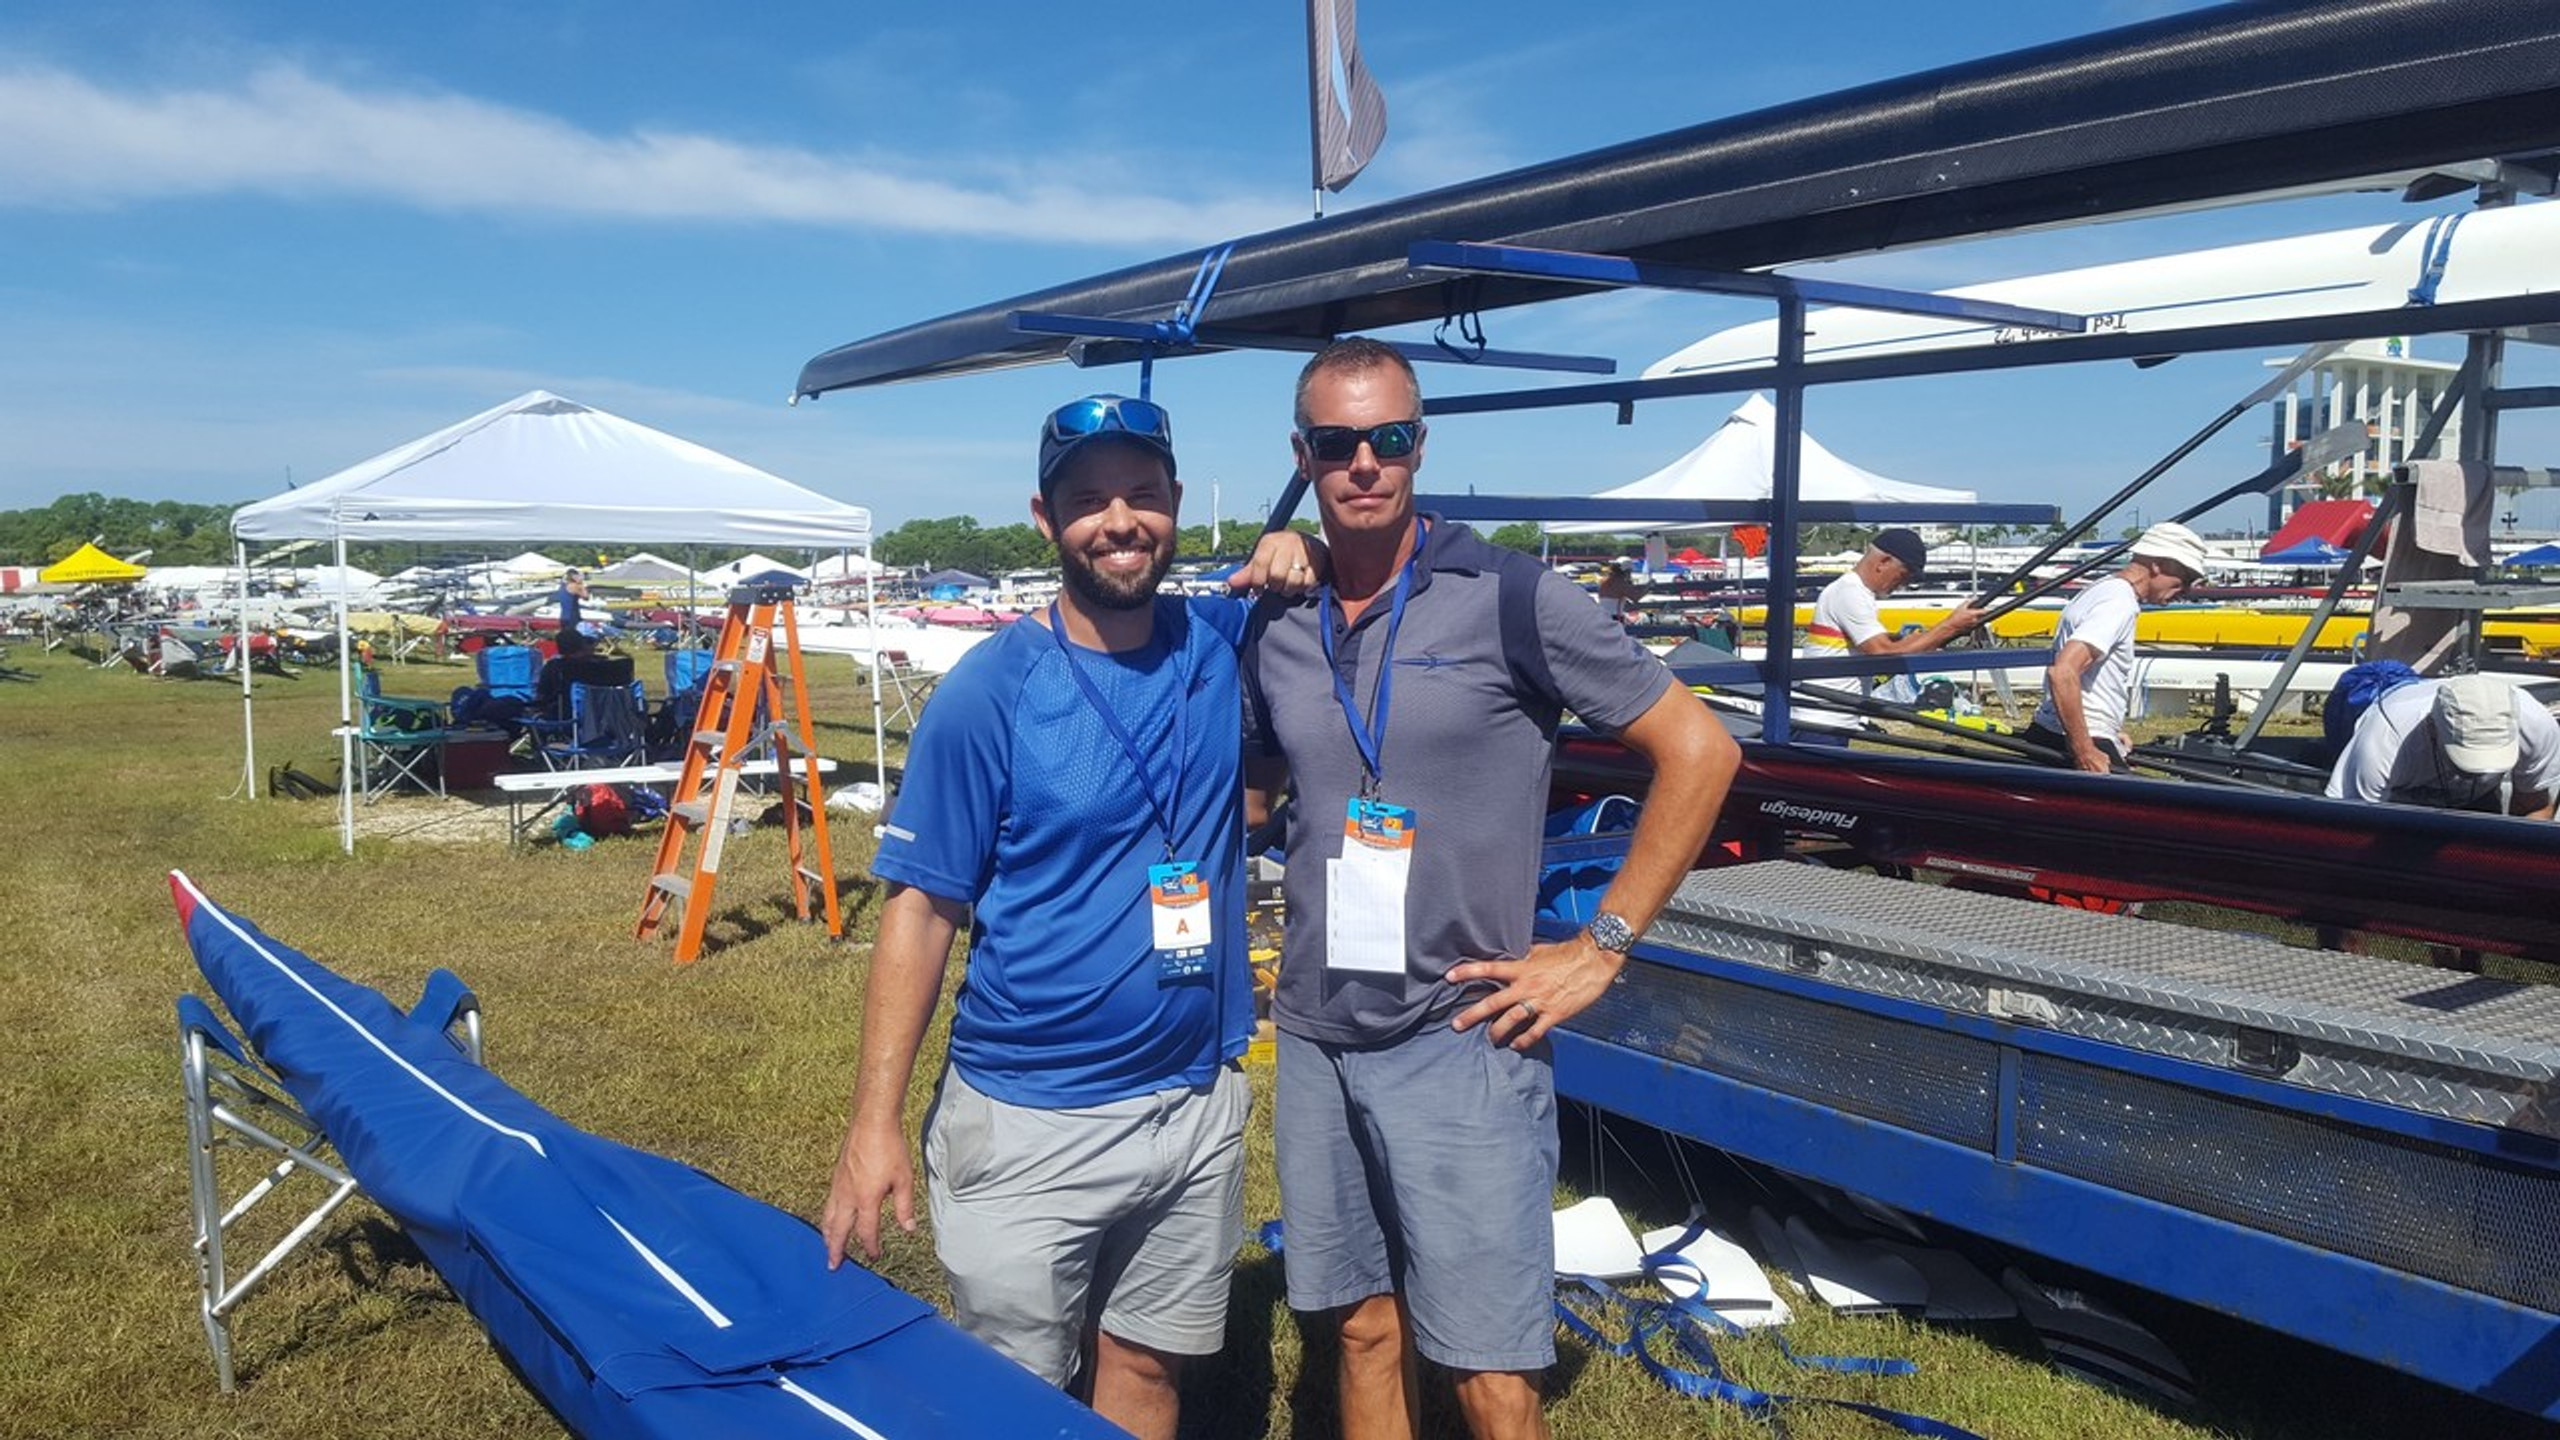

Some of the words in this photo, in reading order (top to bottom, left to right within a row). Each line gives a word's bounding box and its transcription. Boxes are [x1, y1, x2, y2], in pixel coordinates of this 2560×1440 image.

[2092, 312, 2127, 333] Ted
[1759, 800, 1859, 830] Fluidesign
[1176, 917, 1189, 935] A
